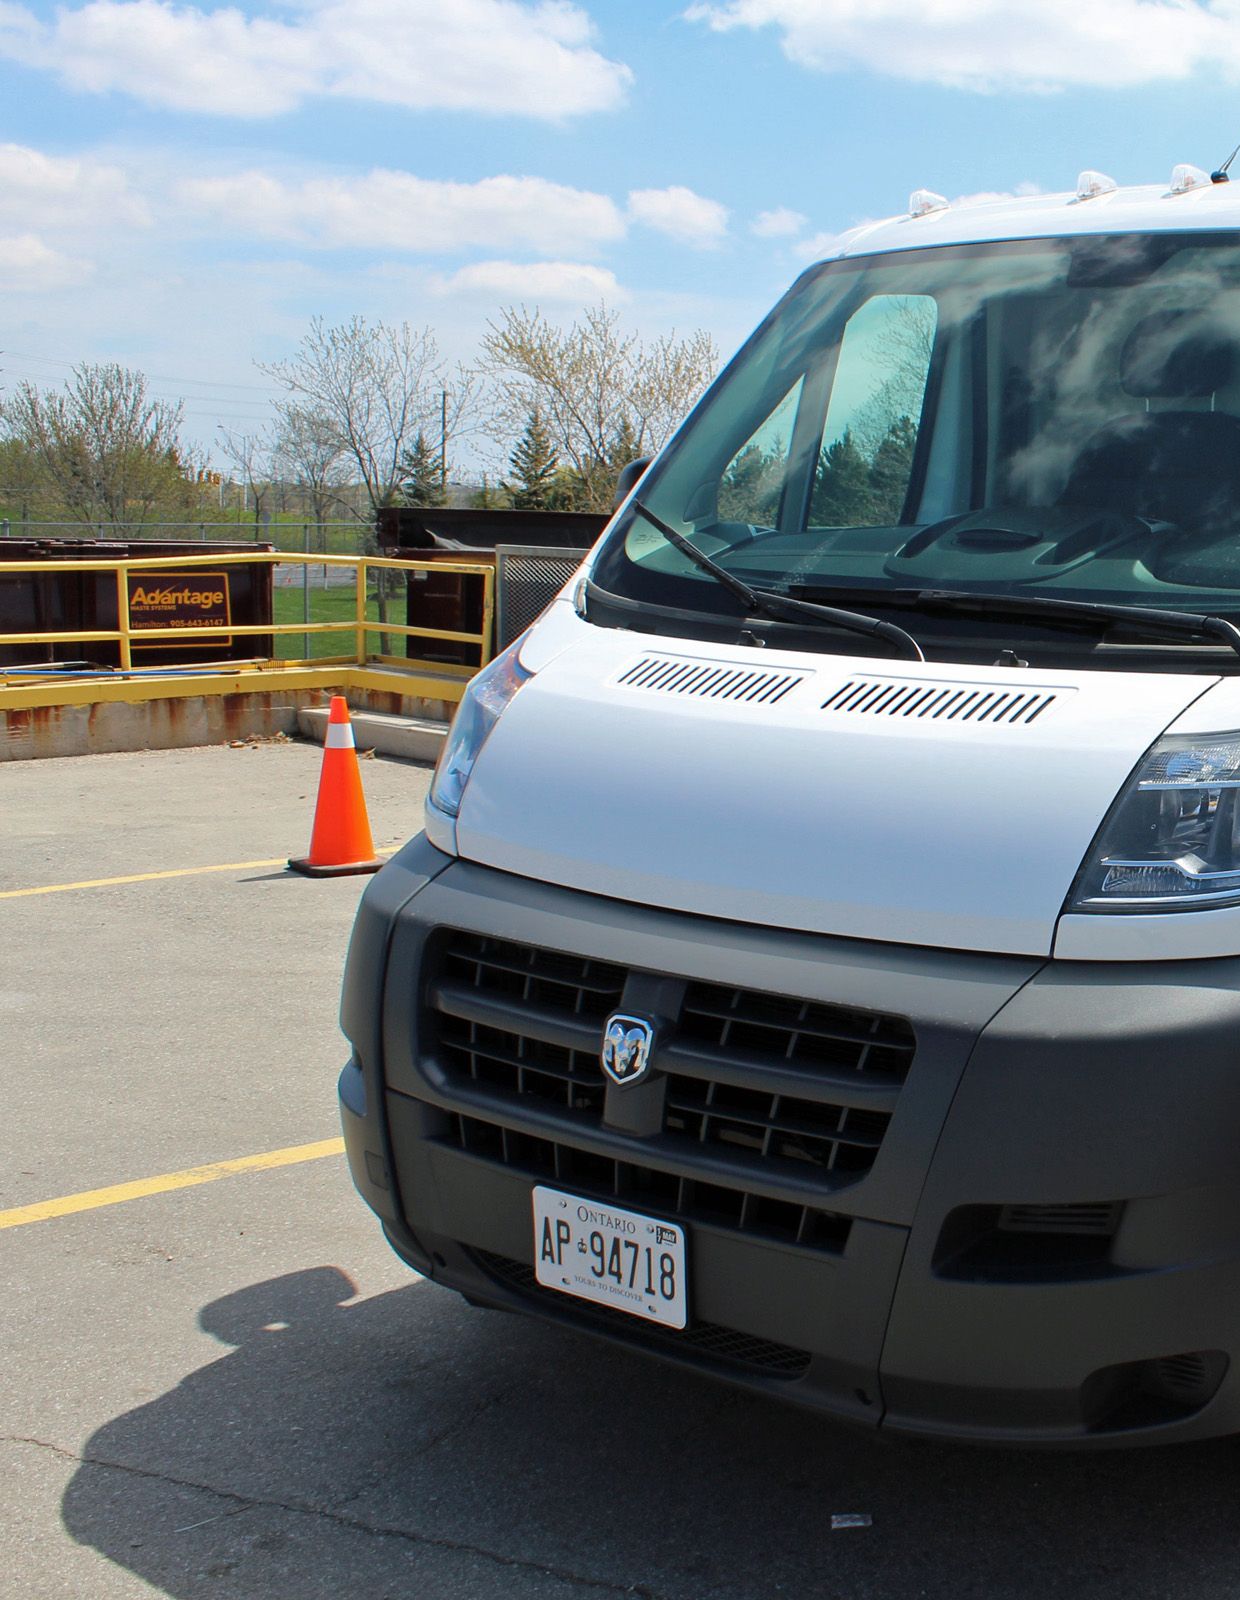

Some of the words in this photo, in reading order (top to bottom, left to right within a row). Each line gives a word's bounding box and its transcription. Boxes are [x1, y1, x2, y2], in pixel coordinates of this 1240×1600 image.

[577, 1205, 636, 1234] ONTARIO
[541, 1216, 570, 1265] AP
[590, 1231, 675, 1300] 94718
